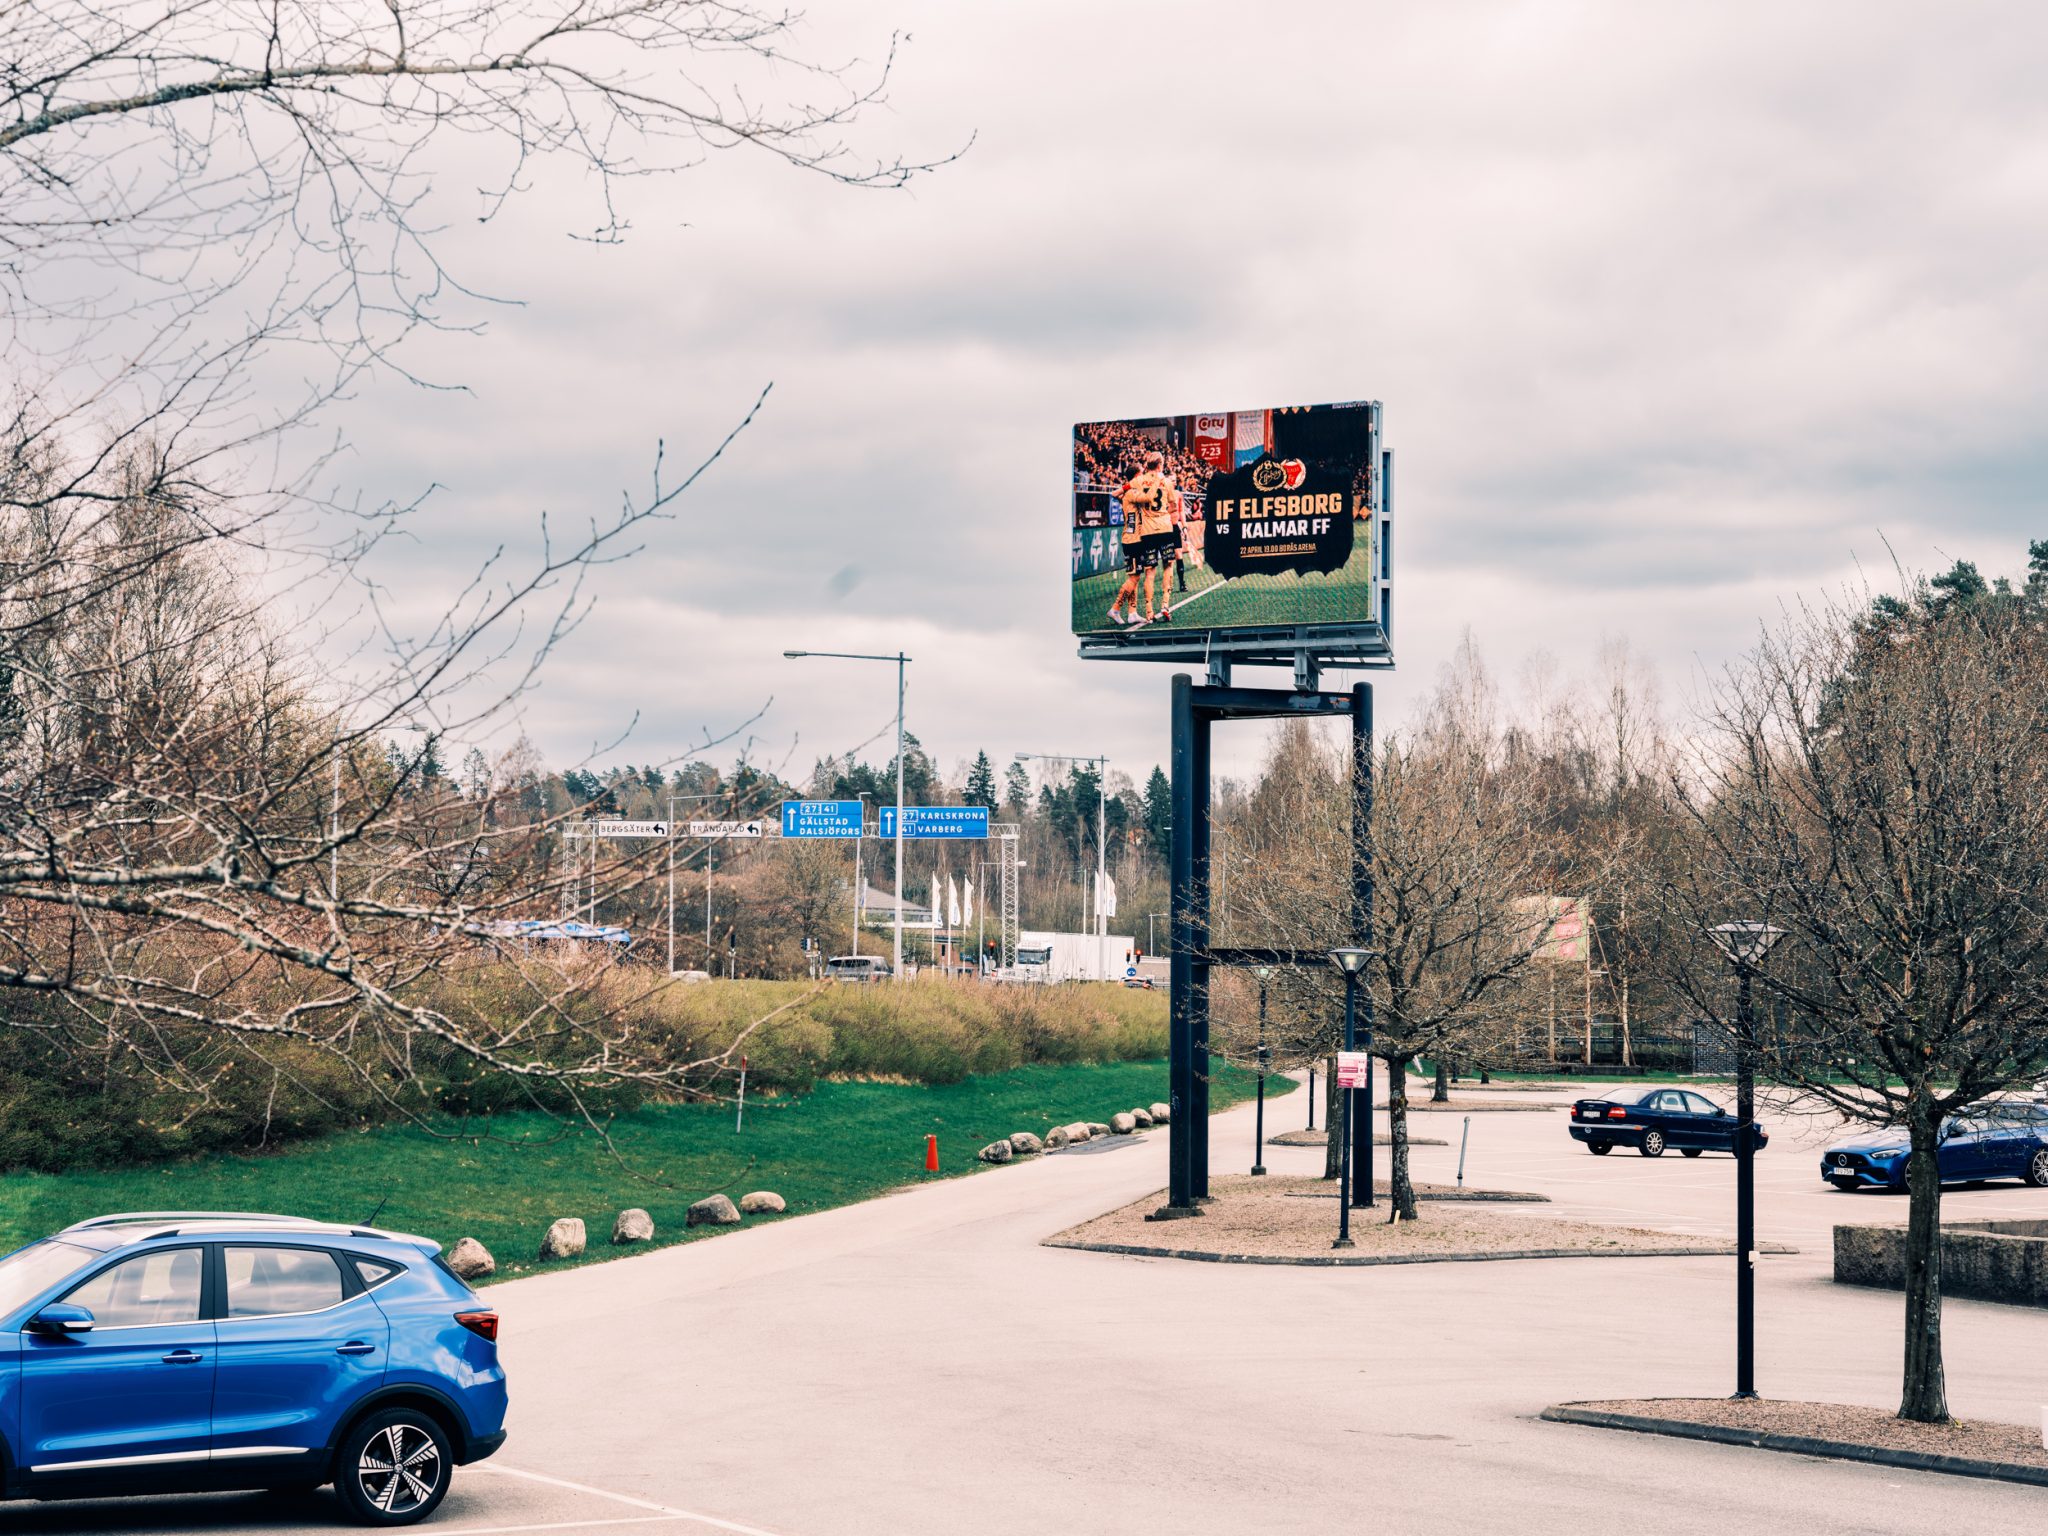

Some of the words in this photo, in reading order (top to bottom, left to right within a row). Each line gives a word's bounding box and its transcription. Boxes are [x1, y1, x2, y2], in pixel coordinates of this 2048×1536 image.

[1201, 447, 1221, 457] 7-23
[1216, 500, 1235, 521] IF
[1240, 493, 1342, 519] ELFSBORG
[1241, 520, 1308, 539] KALMAR
[1312, 518, 1331, 535] FF
[1240, 546, 1247, 555] 22
[1247, 545, 1263, 554] APRIL
[1279, 542, 1297, 552] BORÅS
[1298, 543, 1317, 551] ARENA
[805, 805, 817, 813] 27
[823, 805, 835, 813] 41
[800, 815, 849, 826] GÄLLSTAD
[920, 812, 986, 820] KARLSKRONA
[800, 825, 861, 836] DALSJÖFORS
[918, 825, 963, 833] VARBERG
